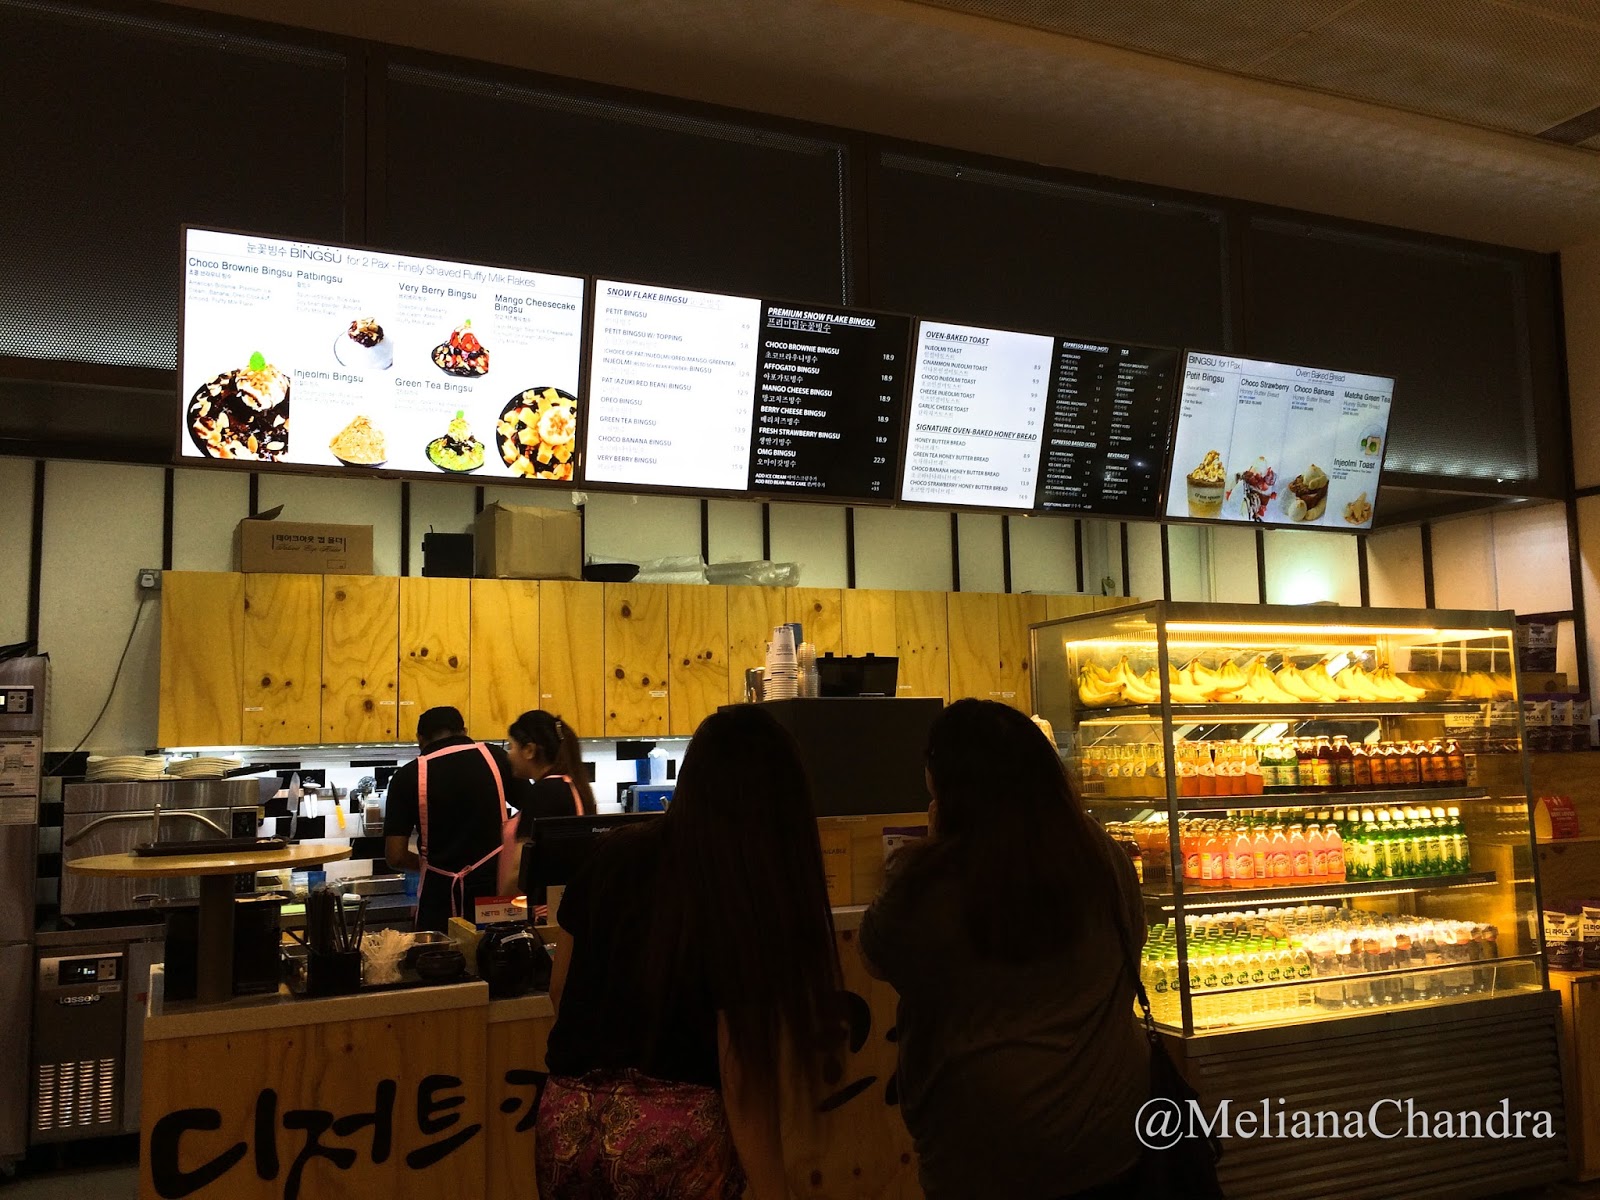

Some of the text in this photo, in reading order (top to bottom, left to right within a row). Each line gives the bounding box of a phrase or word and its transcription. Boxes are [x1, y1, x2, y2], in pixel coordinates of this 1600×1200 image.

[188, 257, 293, 279] Choco Brownie Bingsu
[290, 247, 342, 264] BINGSU
[346, 254, 360, 265] for
[362, 257, 369, 267] 2
[371, 258, 389, 270] Pax
[398, 261, 425, 276] Finely
[426, 265, 461, 278] Shaved
[488, 272, 505, 284] Milk
[507, 275, 536, 287] Flakes
[296, 270, 343, 284] Patbingsu
[398, 282, 477, 300] Very Berry Bingsu
[606, 287, 632, 297] SNOW
[632, 291, 657, 301] FLAKE
[658, 294, 688, 304] BINGSU
[494, 294, 576, 311] Mango Cheesecake
[494, 303, 523, 315] Bingsu
[605, 307, 648, 319] PETIT BINGSU
[767, 307, 876, 327] PREMIUM SNOW FLAKE BINGSU
[604, 327, 621, 336] PETIT
[622, 329, 646, 338] BINGSU
[656, 333, 683, 342] TOPPING
[926, 330, 990, 345] OVEN-BAKED TOAST
[765, 340, 840, 355] CHOCO BROWNIE BINGSU
[924, 344, 946, 352] INJEOLMI
[1063, 342, 1084, 350] ESPRESSO
[764, 362, 820, 374] AFFOGATO BINGSU
[951, 362, 973, 370] INJEOLMI
[973, 364, 988, 372] TOAST
[1188, 356, 1217, 366] BINGSU
[1218, 360, 1226, 368] for
[1230, 362, 1240, 370] Pax
[293, 368, 364, 384] Injeolmi Bingsu
[689, 366, 712, 374] BINGSU
[1295, 368, 1346, 382] Oven Baked Bread
[881, 374, 893, 382] 18.9
[1186, 370, 1225, 384] Petit Bingsu
[395, 377, 473, 393] Green Tea Bingsu
[602, 376, 614, 384] PAT
[668, 383, 692, 391] BINGSU
[1240, 378, 1290, 392] Choco Strawberry
[762, 384, 832, 397] MANGO CHEESE BINGSU
[920, 388, 938, 396] CHEESE
[938, 390, 960, 398] INJEOLMI
[960, 392, 976, 400] TOAST
[1294, 384, 1335, 396] Choco Banana
[600, 396, 643, 406] OREO BINGSU
[1344, 390, 1391, 404] Matcha Green Tea
[760, 406, 826, 418] BERRY CHEESE BINGSU
[918, 402, 936, 410] GARLIC
[936, 404, 954, 412] CHEESE
[954, 406, 970, 414] TOAST
[599, 416, 620, 424] GREEN
[633, 418, 657, 426] BINGSU
[758, 426, 841, 440] FRESH STRAWBERRY BINGSU
[916, 423, 1038, 441] SIGNATURE OVEN-BAKED HONEY BREAD
[598, 435, 621, 443] CHOCO
[622, 436, 648, 445] BANANA
[876, 436, 888, 444] 18.9
[932, 438, 950, 446] BUTTER
[1051, 438, 1072, 446] ESPRESSO
[1072, 440, 1084, 448] BASED
[597, 454, 613, 462] VERY
[634, 456, 658, 464] BINGSU
[757, 448, 797, 458] OMG BINGSU
[873, 456, 886, 464] 22.9
[1334, 458, 1376, 470] Injeolmi Toast
[928, 466, 949, 474] BANANA
